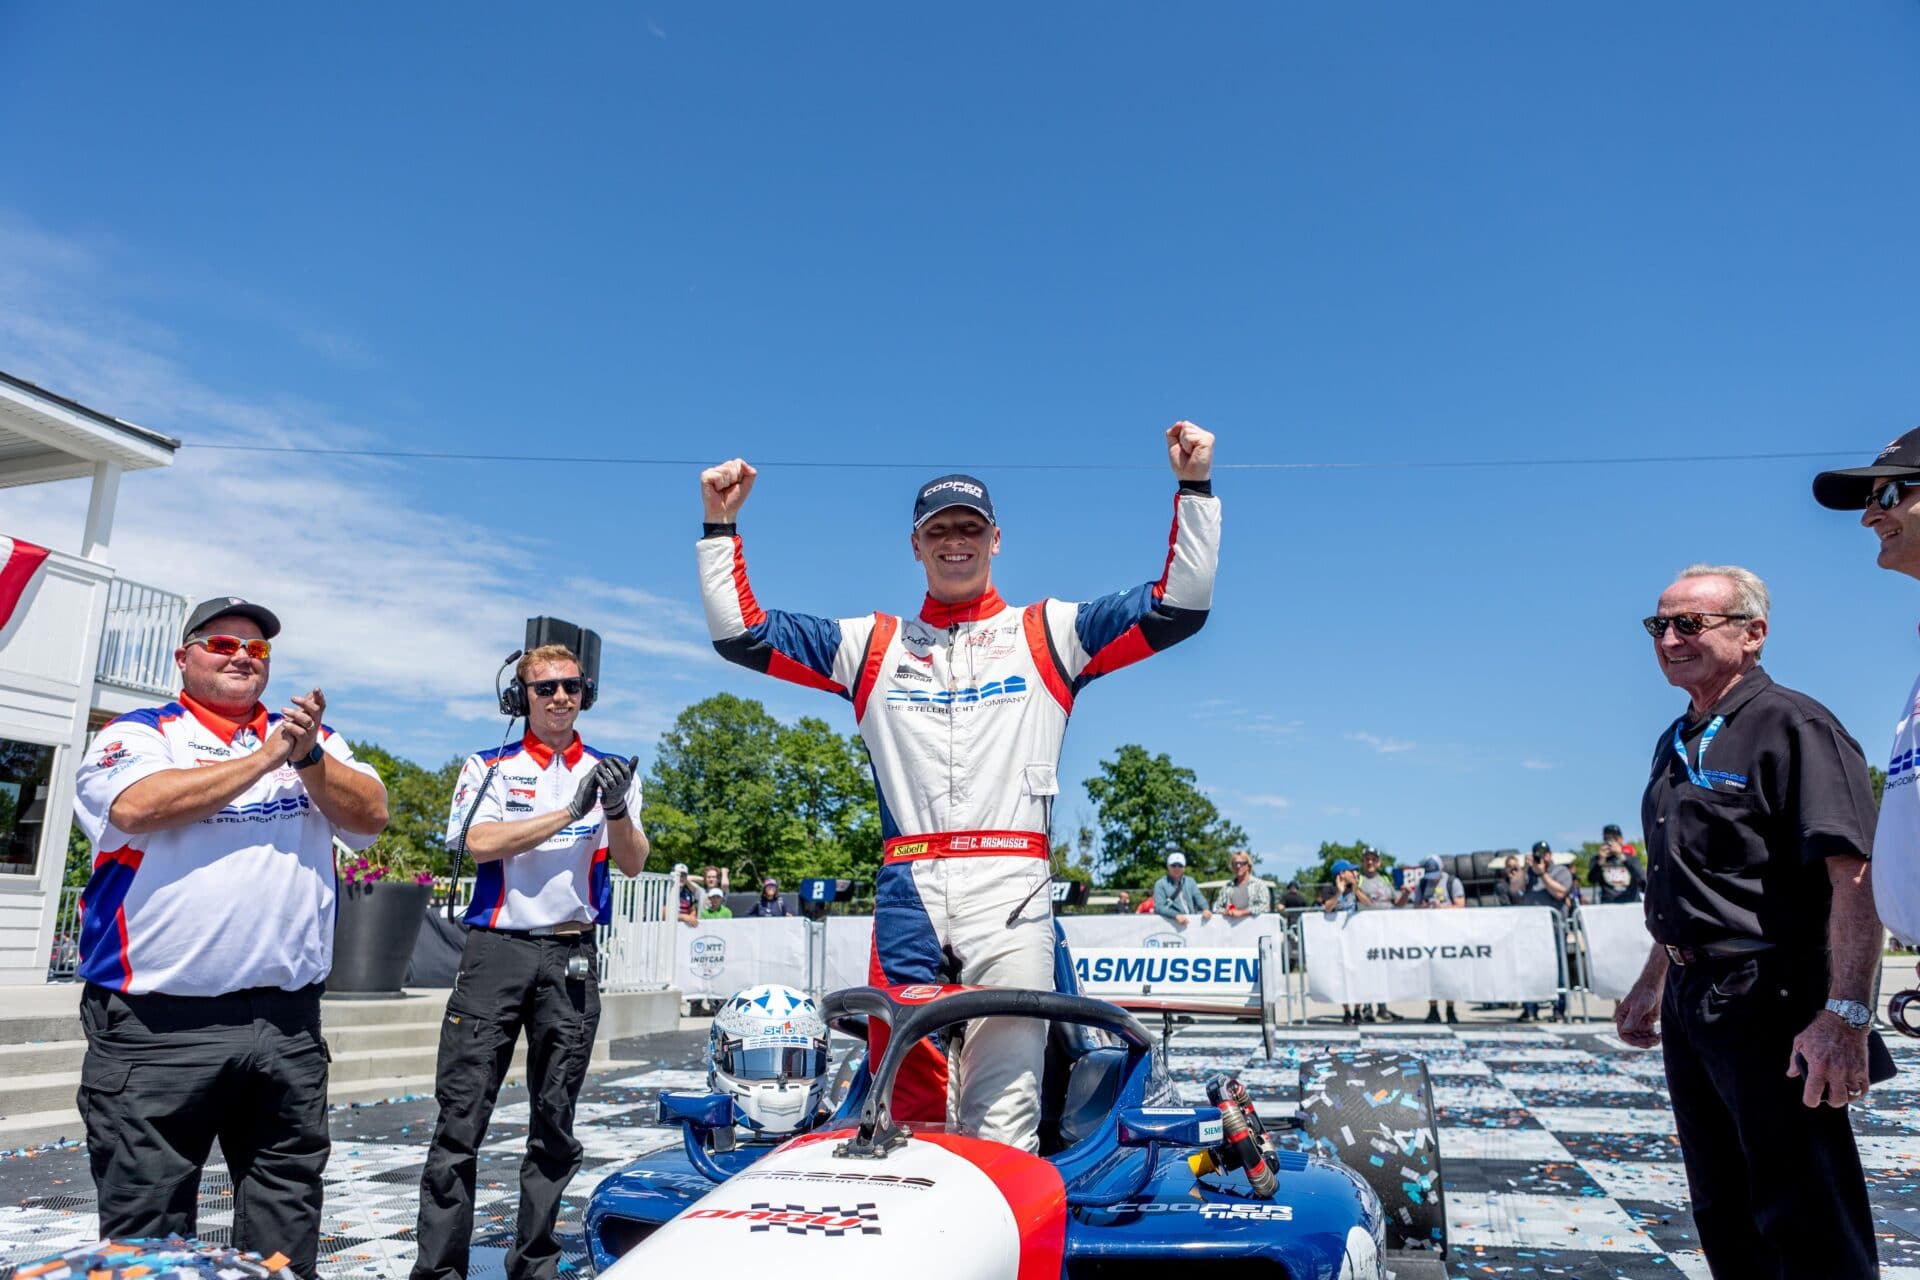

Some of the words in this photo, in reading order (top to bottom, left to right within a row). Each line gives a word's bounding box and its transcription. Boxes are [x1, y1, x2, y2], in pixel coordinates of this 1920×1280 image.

[923, 481, 983, 498] COOPER
[897, 842, 924, 856] Sabelt
[981, 837, 1028, 849] RASMUSSEN
[812, 881, 824, 899] 2
[706, 943, 722, 951] NTT
[1366, 945, 1492, 961] #INDYCAR
[1106, 1203, 1293, 1213] COOPER
[1203, 1211, 1293, 1221] TIRES
